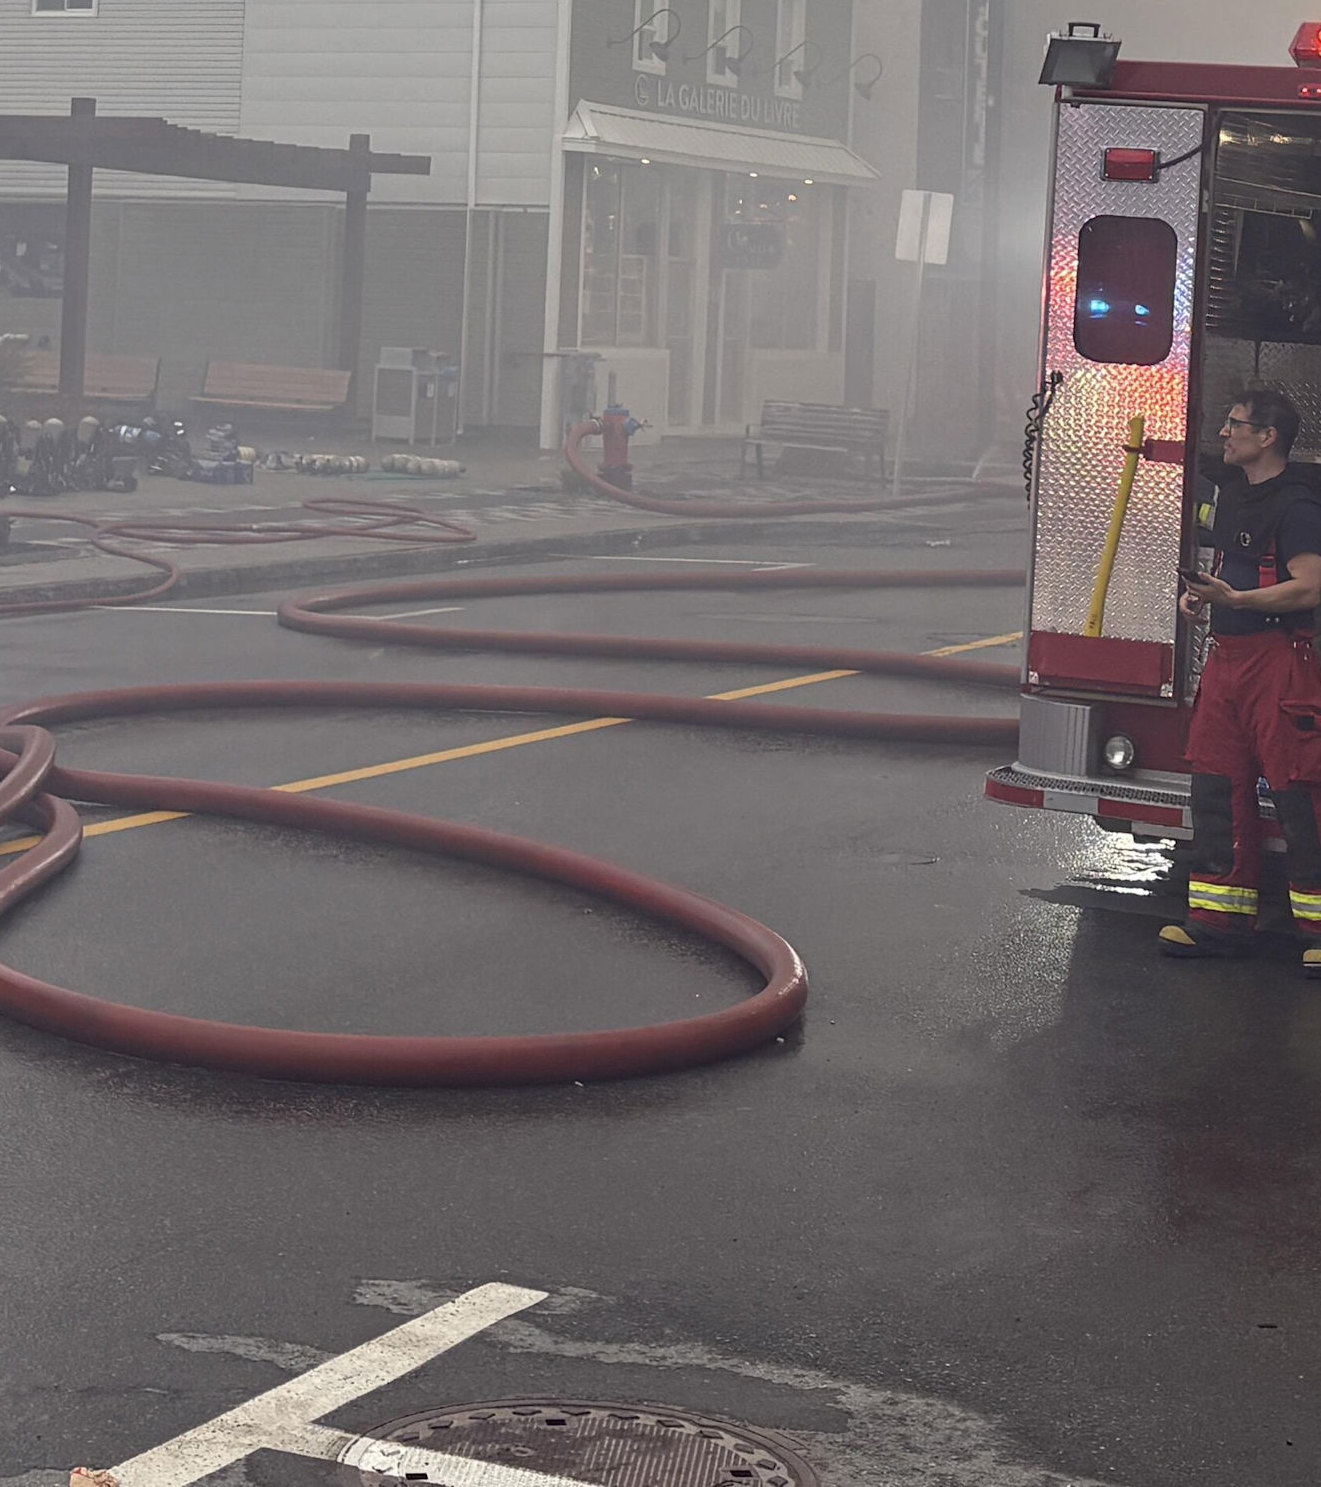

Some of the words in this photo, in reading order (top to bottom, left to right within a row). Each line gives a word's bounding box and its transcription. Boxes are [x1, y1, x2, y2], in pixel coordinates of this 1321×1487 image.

[658, 80, 675, 108] LA
[679, 85, 737, 119] GALERIE
[740, 95, 760, 123] DU
[764, 100, 800, 129] LIVRE
